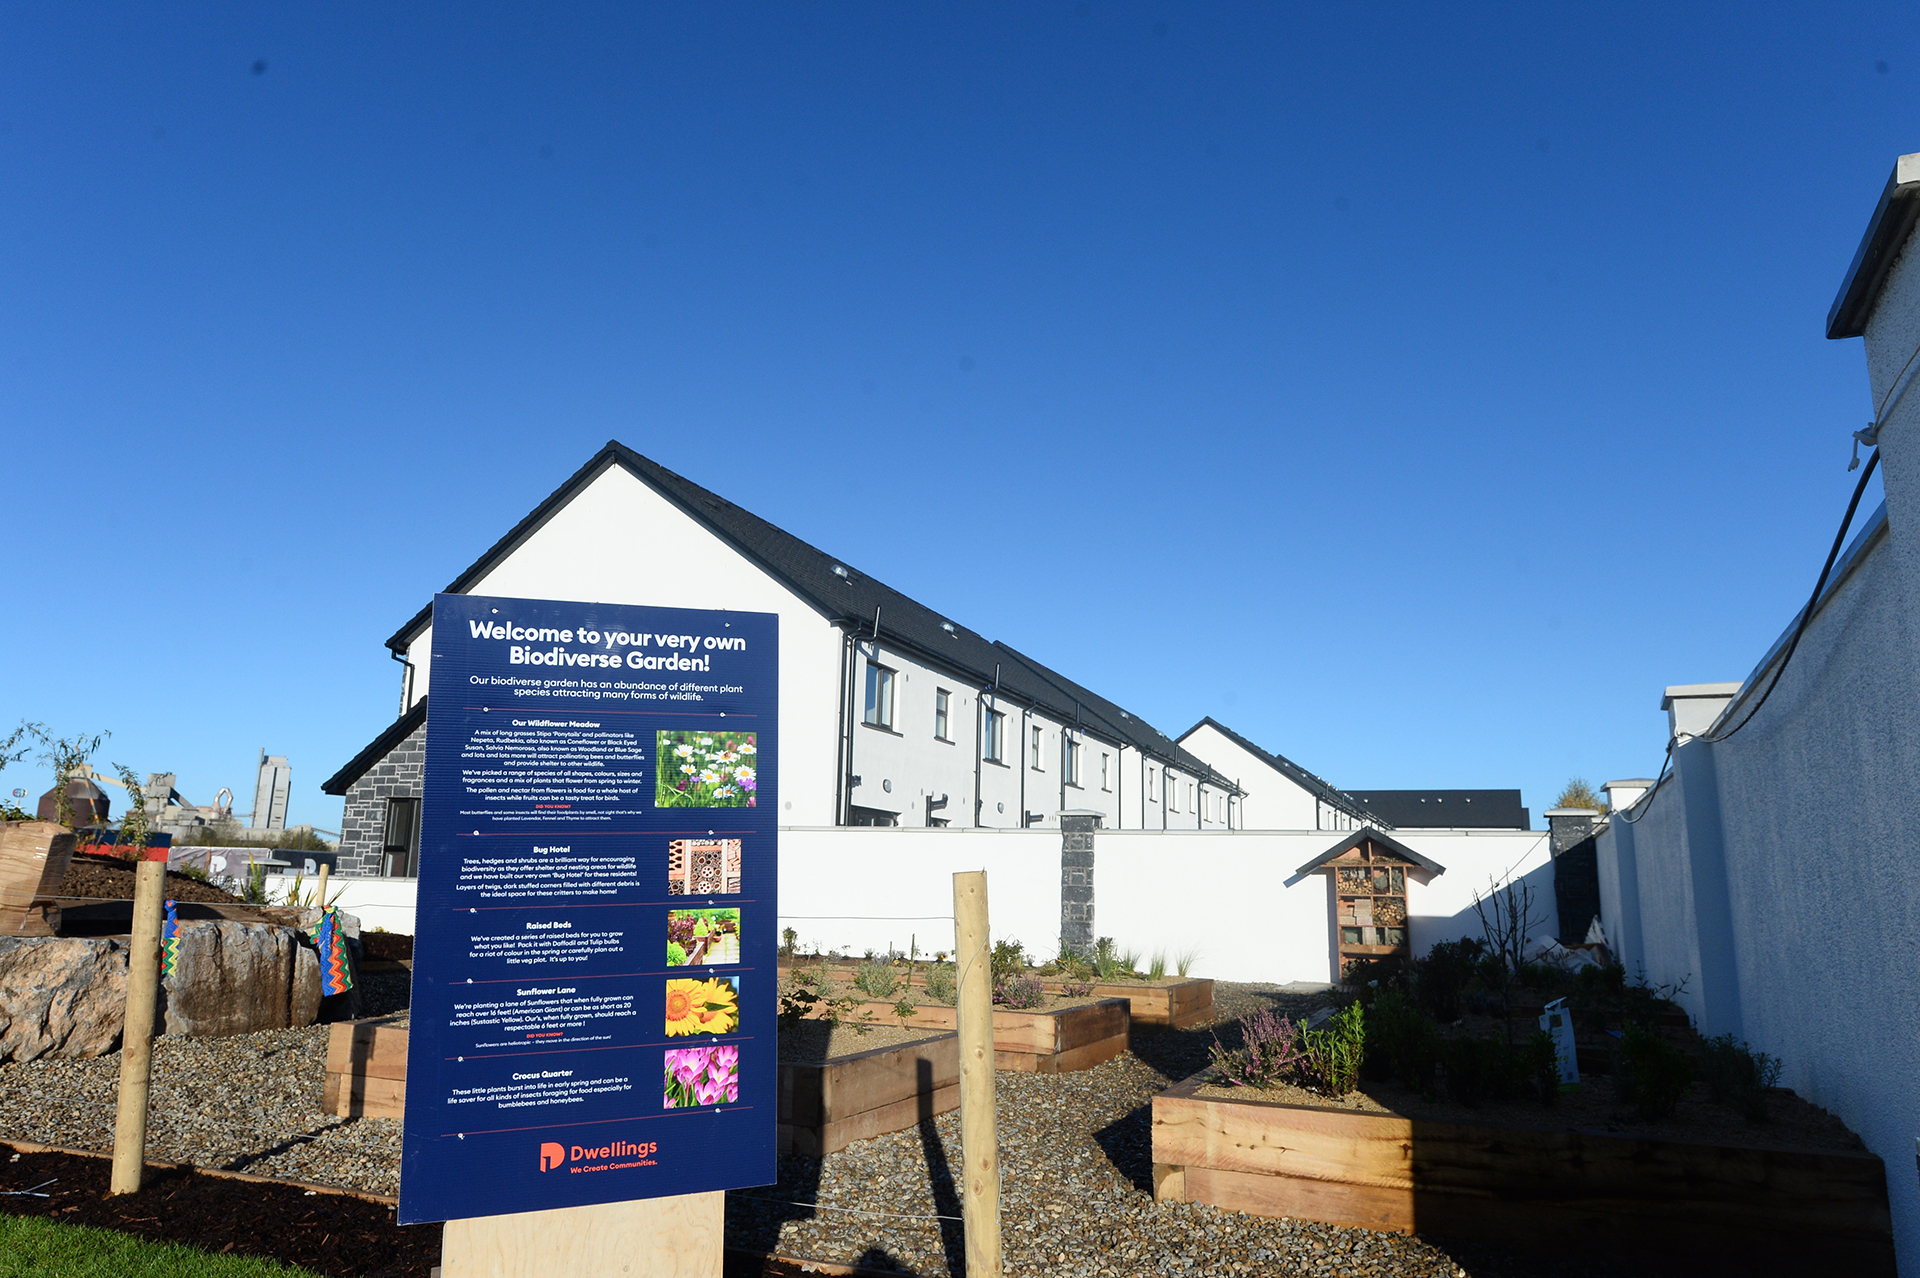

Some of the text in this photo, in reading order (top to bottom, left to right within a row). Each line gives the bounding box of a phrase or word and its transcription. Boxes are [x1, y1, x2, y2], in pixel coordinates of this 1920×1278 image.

[469, 619, 746, 653] Welcome to your very own
[509, 645, 710, 672] Biodiverse Garden!
[469, 675, 489, 684] Our
[490, 675, 542, 686] biodiverse
[543, 678, 578, 688] garden
[580, 678, 598, 688] has
[613, 680, 667, 690] abundance
[668, 682, 678, 691] of
[679, 682, 718, 692] different
[719, 684, 743, 694] plant
[513, 688, 704, 701] species attracting many forms of wildlife.
[511, 718, 600, 728] Our Wildflower Meadow
[499, 729, 513, 737] long
[533, 845, 570, 854] Bug Hotel
[526, 920, 571, 929] Raised Beds
[533, 956, 547, 964] plot.
[574, 954, 588, 962] you!
[516, 986, 576, 996] Sunflower Lane
[511, 1007, 543, 1015] (American
[543, 1005, 563, 1013] Giant)
[503, 1023, 540, 1031] respectable
[512, 1069, 573, 1080] Crocus Quarter
[542, 1089, 568, 1097] foraging
[578, 1086, 593, 1094] food
[592, 1084, 623, 1093] especially
[497, 1100, 536, 1108] bumblebees
[549, 1096, 584, 1104] honeybees.
[570, 1140, 657, 1161] Dwellings
[569, 1159, 657, 1174] We Create Communities.
